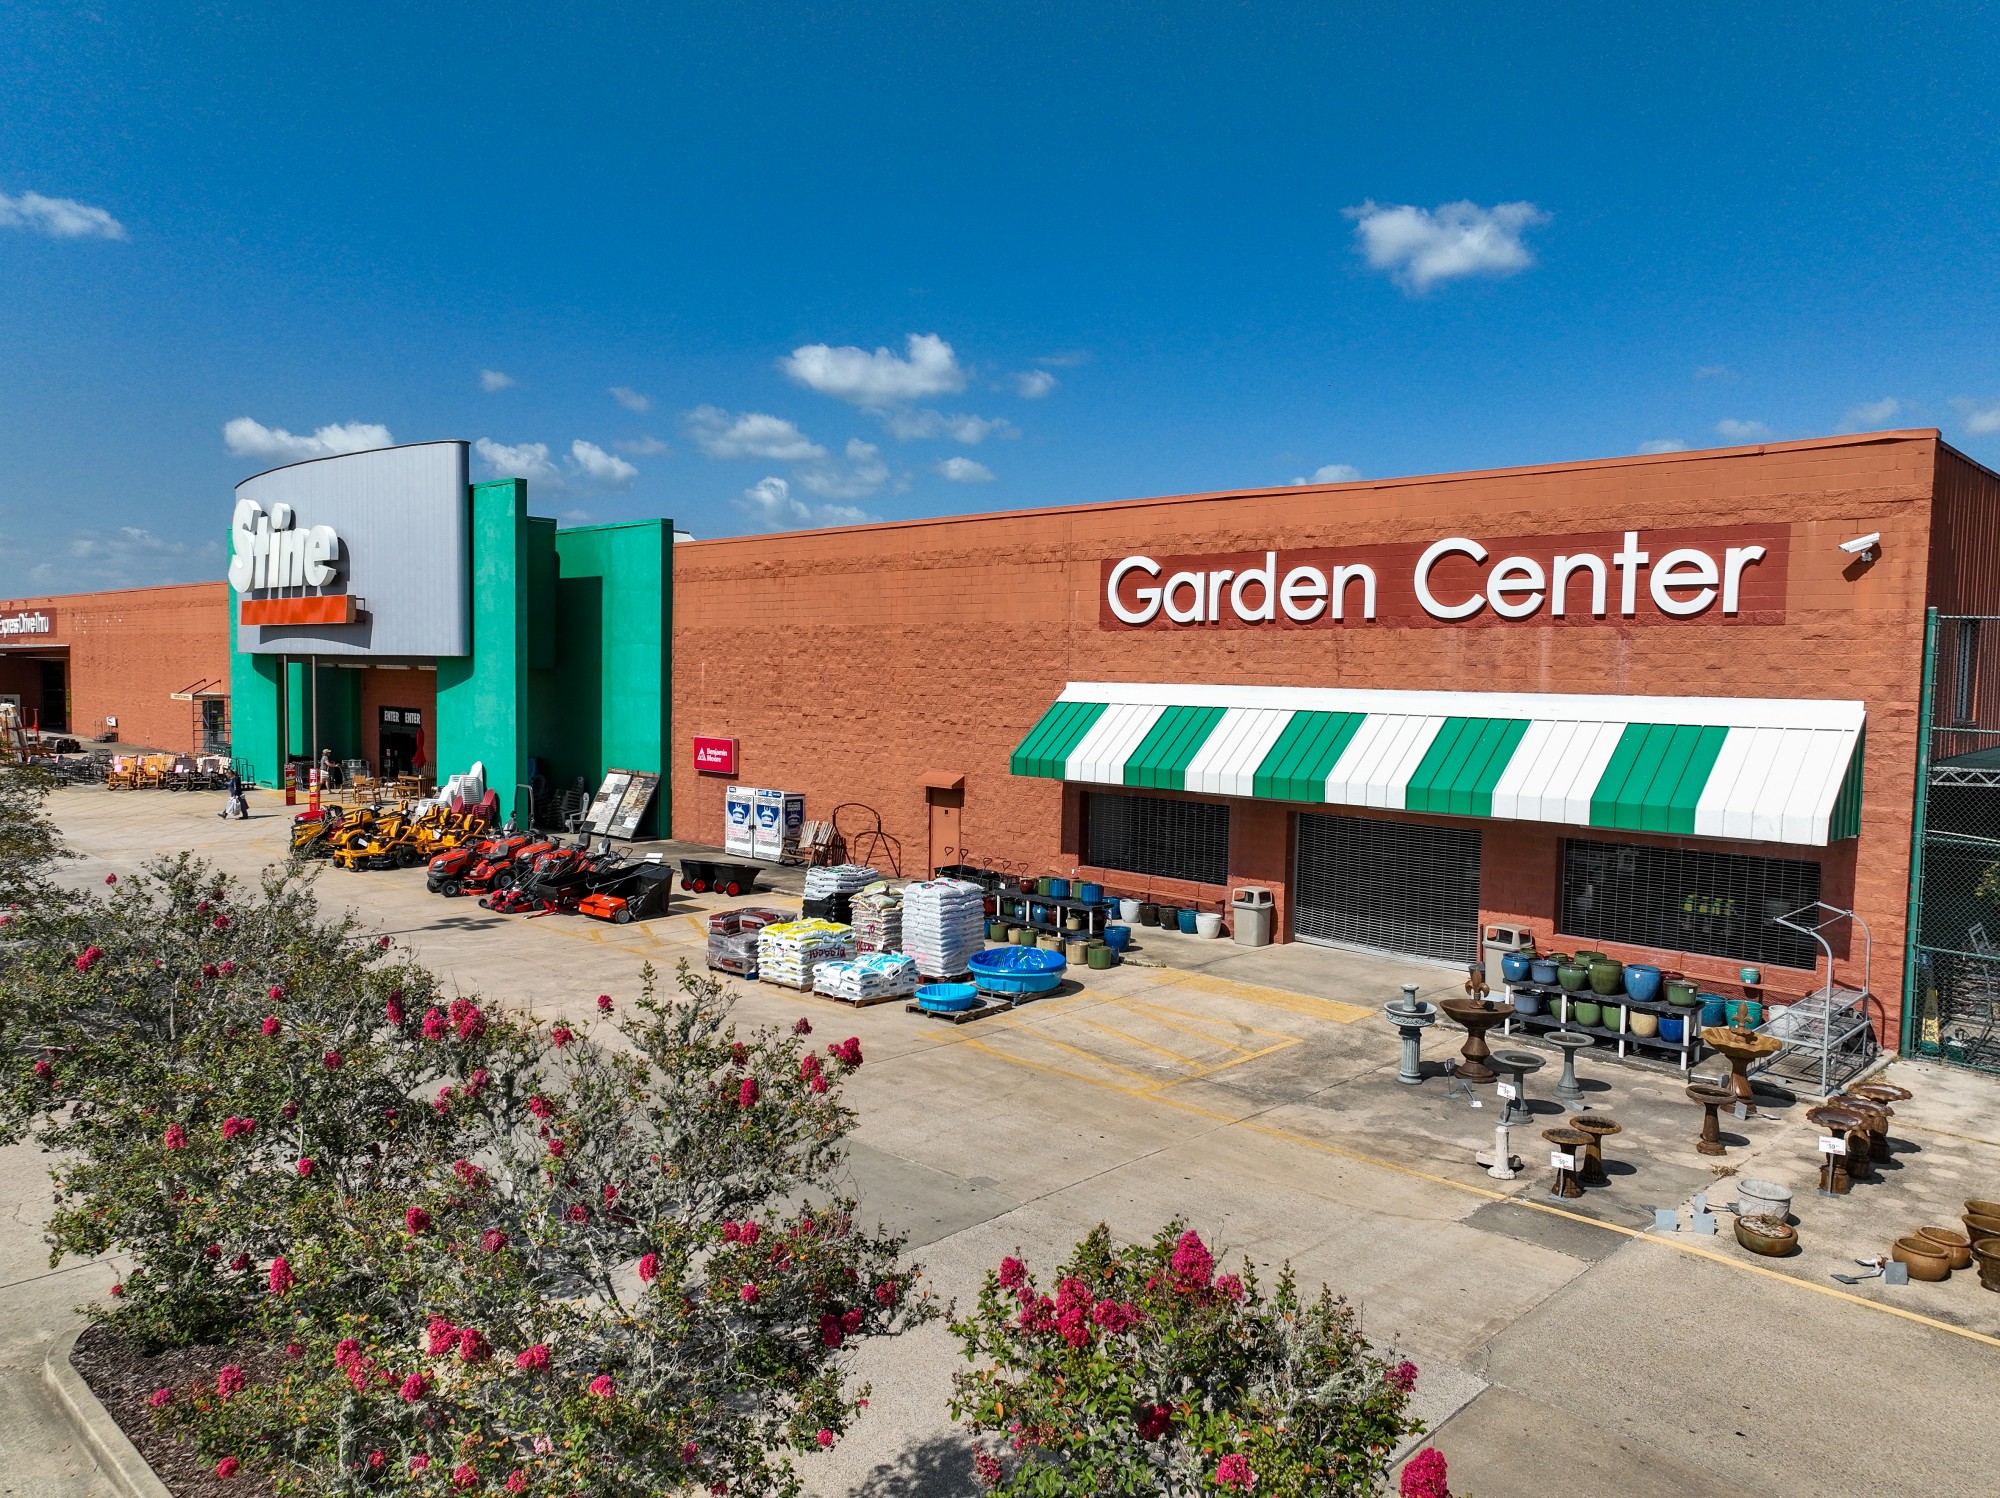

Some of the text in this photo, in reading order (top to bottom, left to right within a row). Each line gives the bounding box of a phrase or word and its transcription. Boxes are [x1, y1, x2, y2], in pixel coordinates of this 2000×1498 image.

[228, 499, 338, 593] Stine
[1107, 531, 1766, 624] Garden Center
[384, 710, 399, 722] ENTER
[405, 712, 420, 724] ENTER
[706, 747, 728, 756] Benjamin
